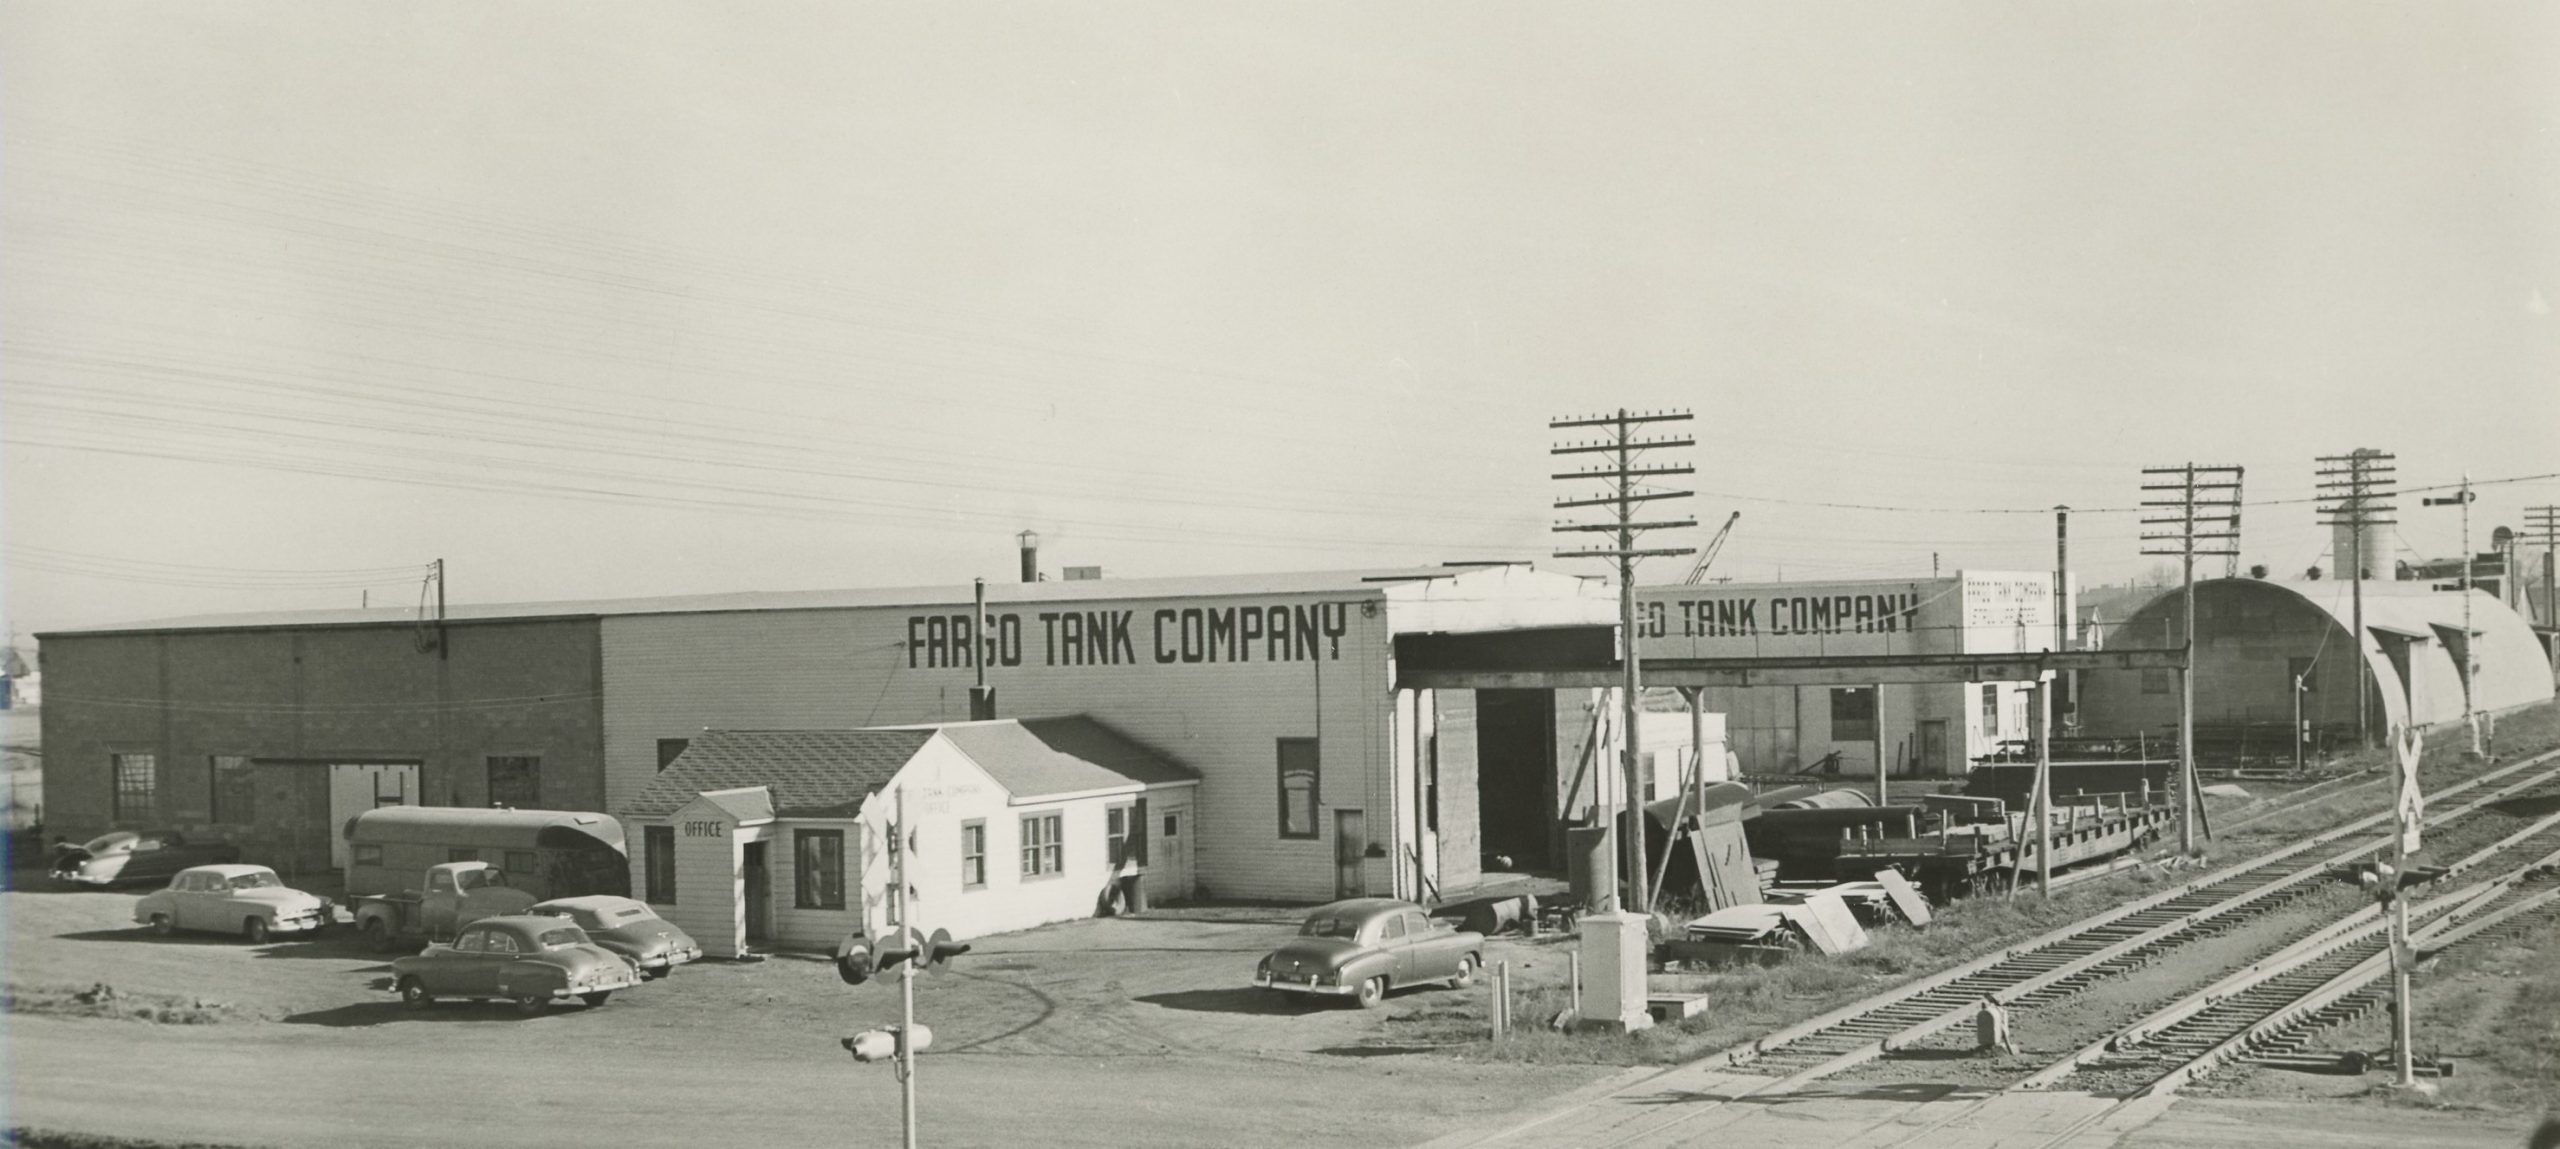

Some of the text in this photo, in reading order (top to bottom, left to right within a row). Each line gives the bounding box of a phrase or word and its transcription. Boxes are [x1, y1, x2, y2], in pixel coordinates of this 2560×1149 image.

[1039, 609, 1136, 667] TANK
[1154, 602, 1347, 665] COMPANY
[1678, 598, 1757, 638] TANK
[1770, 592, 1919, 636] COMPANY
[684, 820, 723, 838] OFFICE
